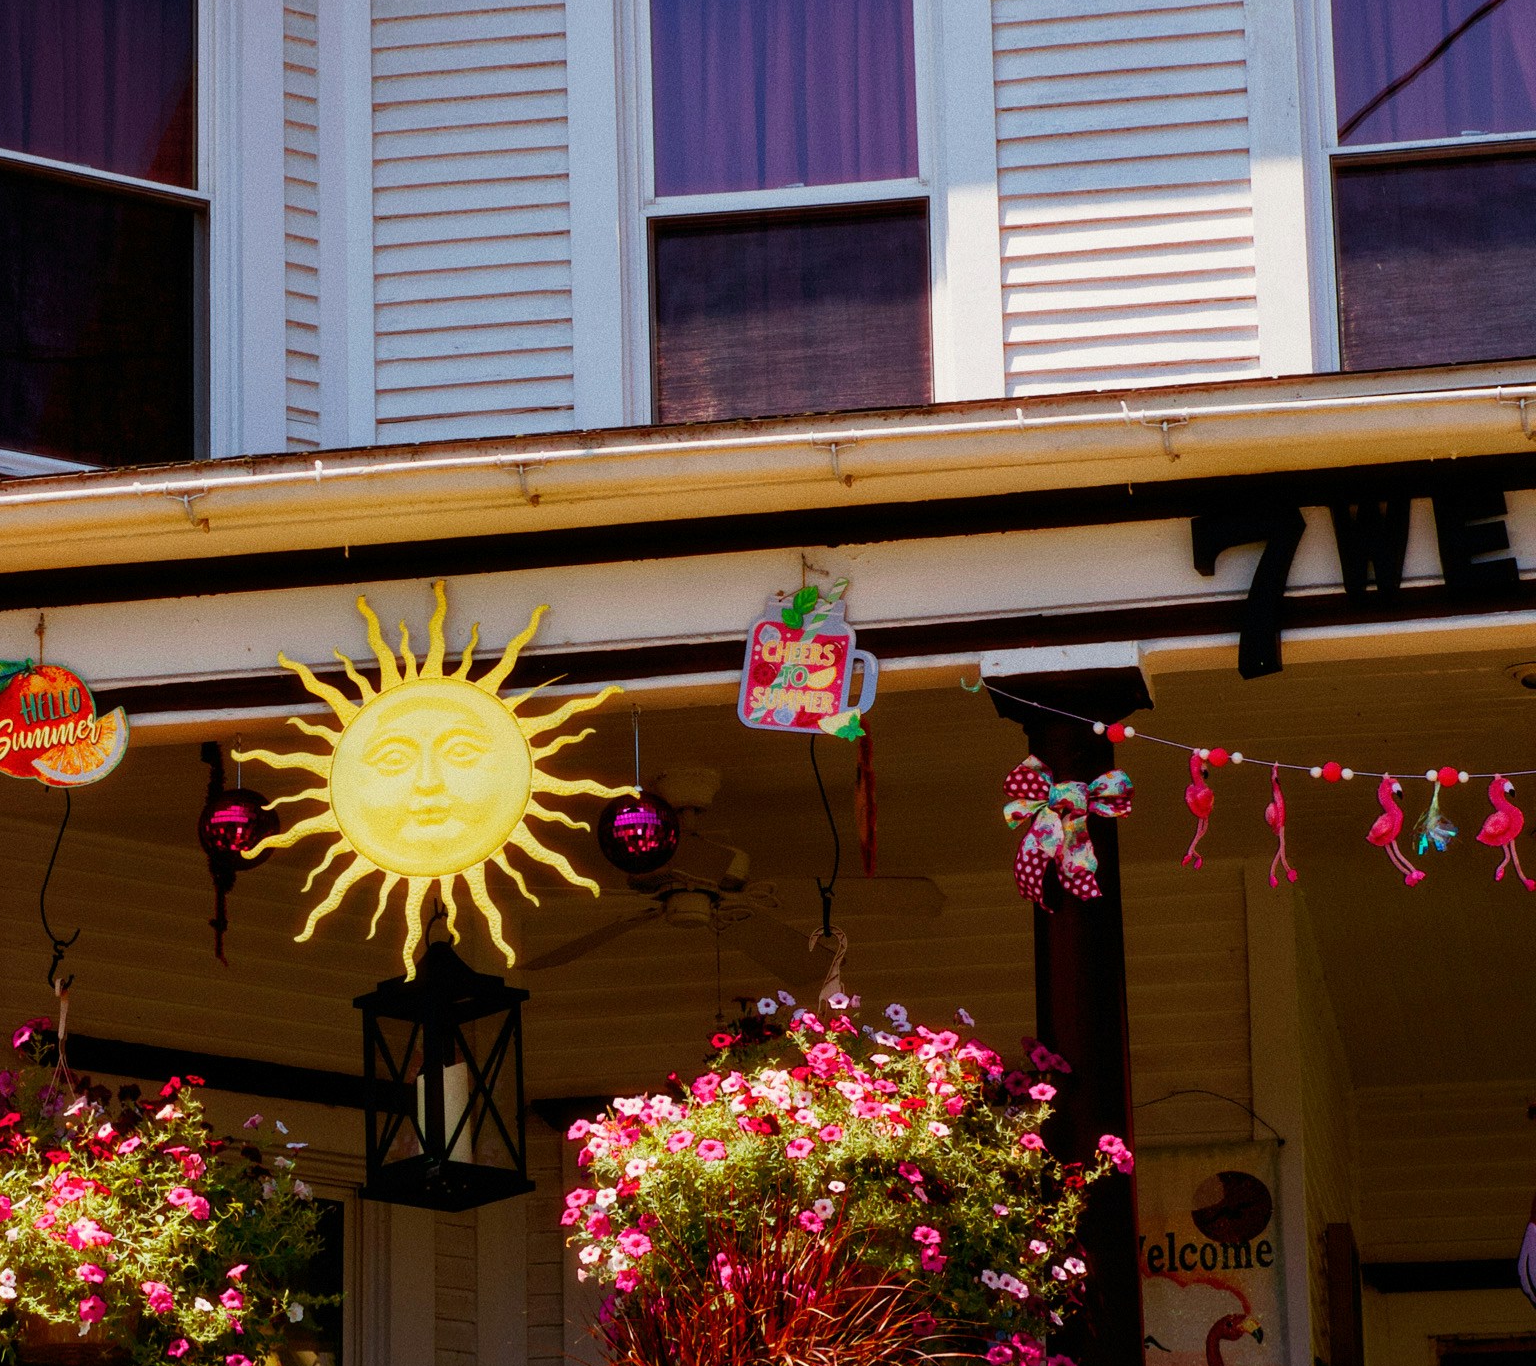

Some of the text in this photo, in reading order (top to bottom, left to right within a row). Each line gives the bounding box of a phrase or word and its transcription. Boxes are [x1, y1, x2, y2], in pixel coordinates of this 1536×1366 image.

[1191, 485, 1305, 678] 7
[762, 640, 835, 666] CHEERS
[782, 665, 809, 687] TO
[20, 687, 81, 724] HELLO
[750, 686, 834, 714] SUMMER
[1138, 1232, 1270, 1272] elcome
